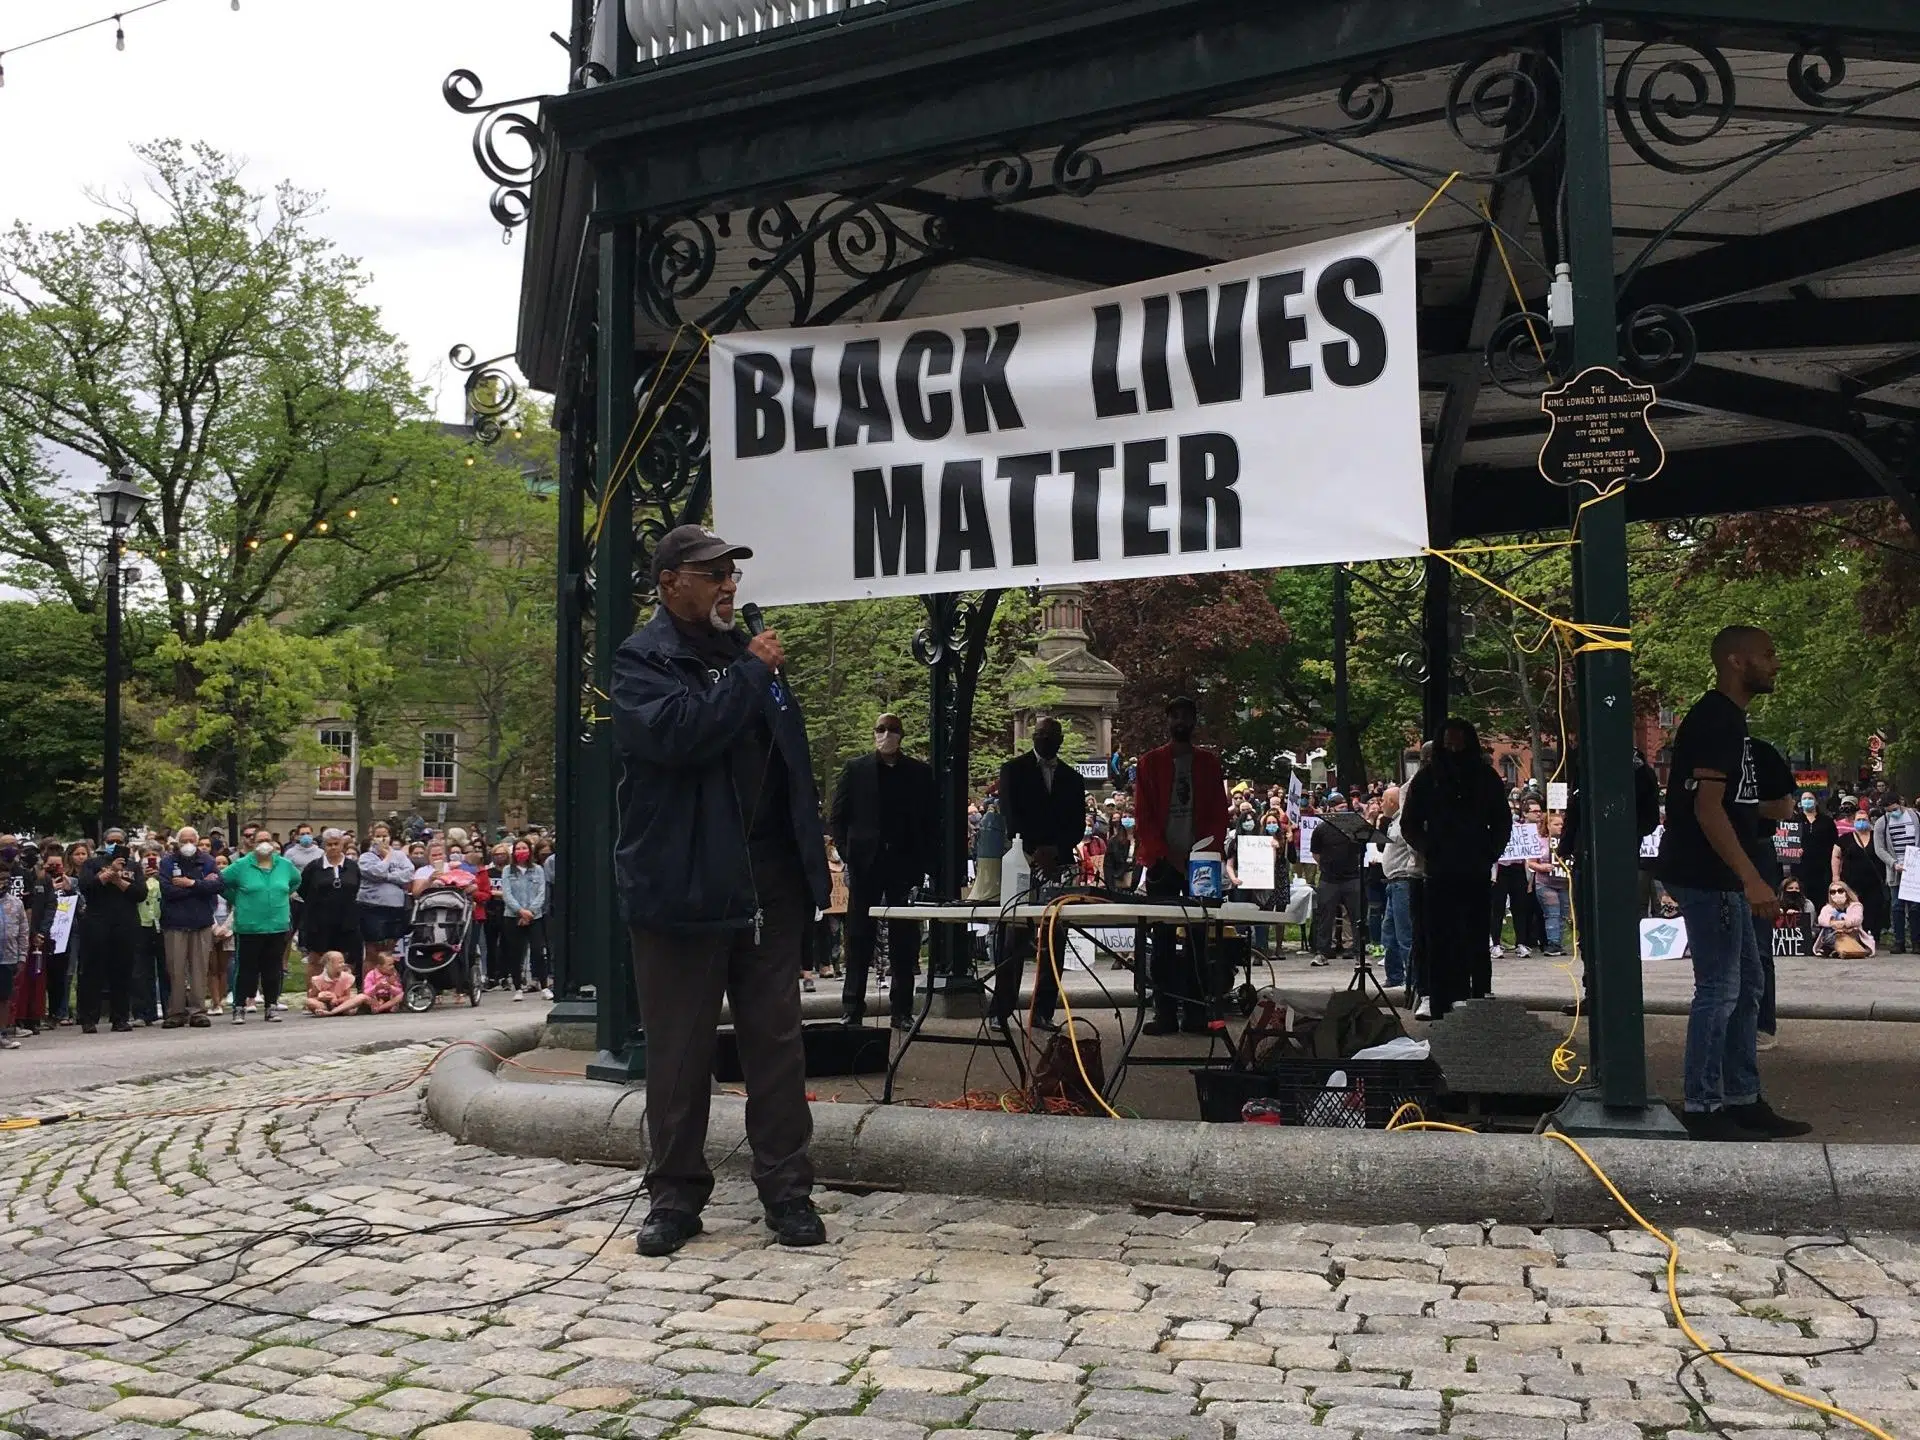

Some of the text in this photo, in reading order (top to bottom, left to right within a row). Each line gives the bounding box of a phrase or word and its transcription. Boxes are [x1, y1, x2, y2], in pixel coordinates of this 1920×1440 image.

[732, 256, 1389, 460] BLACK LIVES
[1590, 385, 1605, 394] THE
[1547, 393, 1651, 408] KING EDWARD VII BANDSTAND
[1557, 415, 1571, 423] BUILT
[1585, 412, 1609, 421] DONATED
[1610, 427, 1625, 435] BAND
[1582, 451, 1604, 459] REPAIRS
[1605, 450, 1626, 458] FUNDED
[1563, 460, 1585, 468] RICHARD
[852, 431, 1243, 580] MATTER
[1076, 765, 1106, 776] RAYER?
[1773, 928, 1803, 940] KILLS
